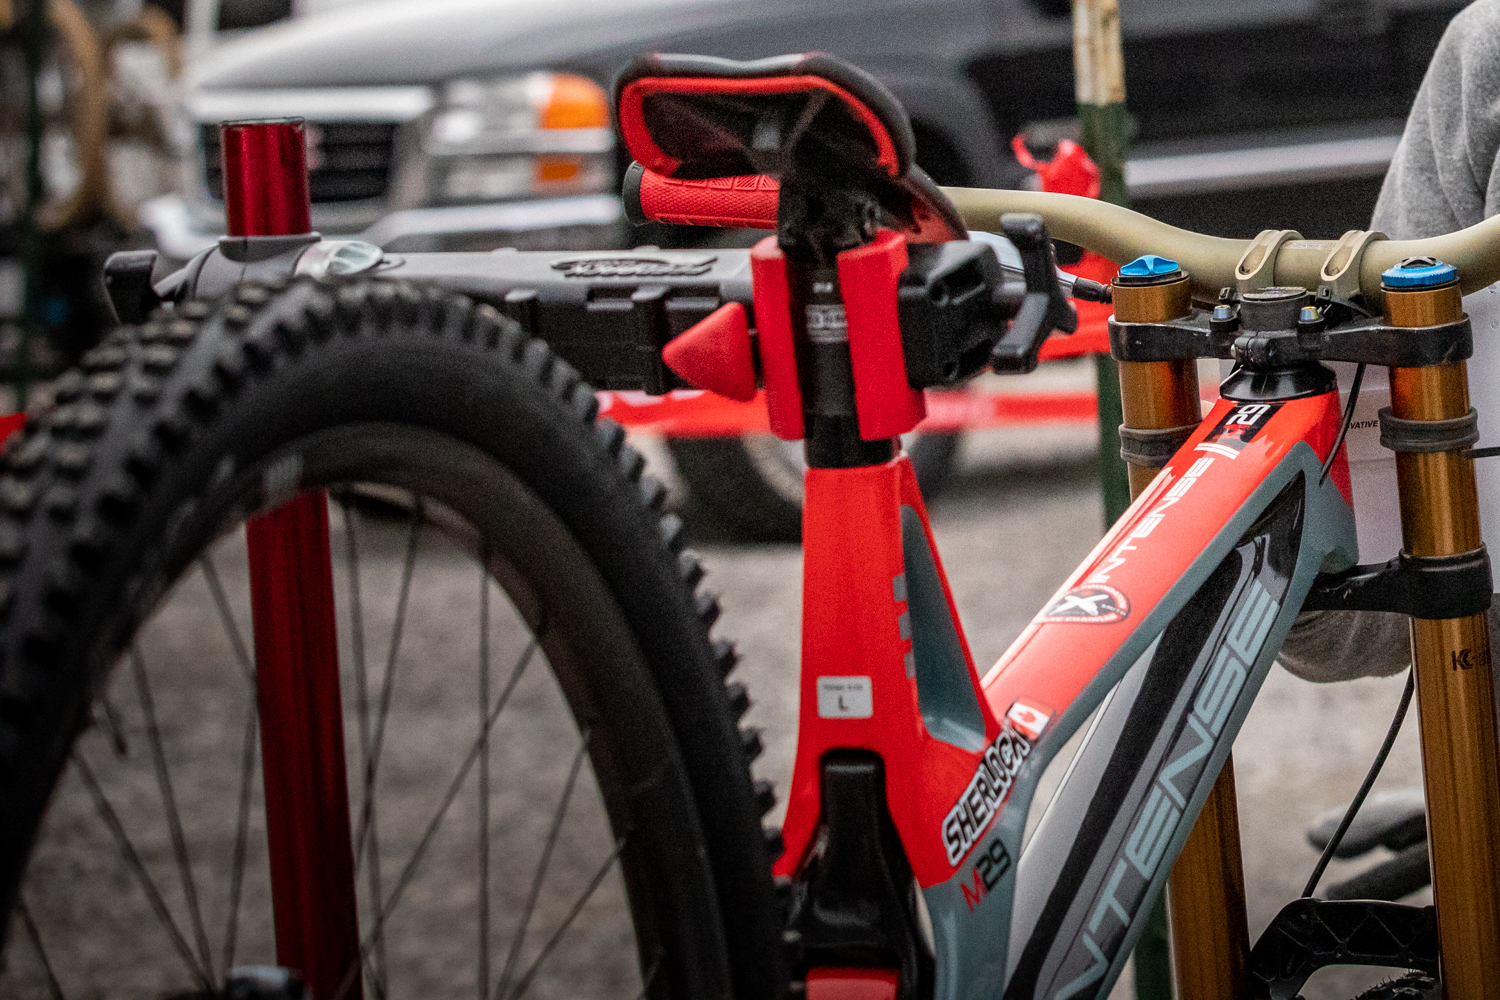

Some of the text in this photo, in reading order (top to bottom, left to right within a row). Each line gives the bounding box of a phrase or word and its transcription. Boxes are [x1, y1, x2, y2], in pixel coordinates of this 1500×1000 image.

[1349, 420, 1379, 429] VATIVE
[1089, 457, 1215, 583] INTENSE
[838, 695, 849, 711] L
[942, 726, 1031, 867] SHERLOCK
[1055, 579, 1280, 1000] NTENSE
[960, 837, 1011, 913] M29
